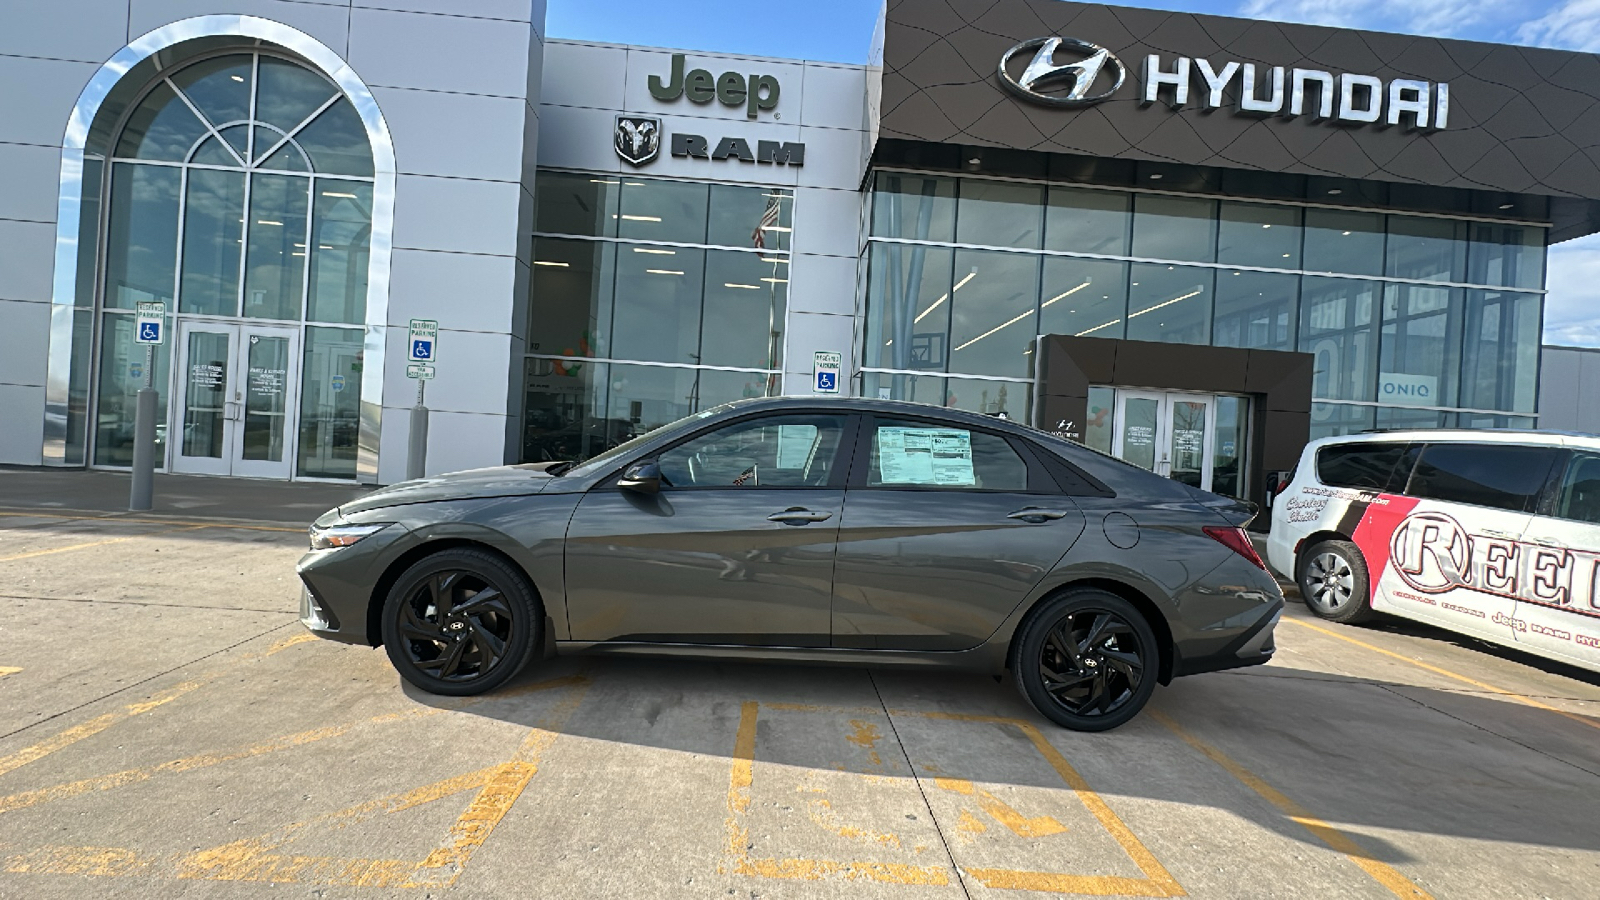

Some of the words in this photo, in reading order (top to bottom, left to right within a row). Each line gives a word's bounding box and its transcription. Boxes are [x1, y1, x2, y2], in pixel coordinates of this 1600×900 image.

[648, 53, 780, 119] Jeep
[1143, 53, 1449, 133] HYUNDAI
[671, 132, 806, 167] RAM
[138, 311, 164, 319] PARKING
[411, 329, 436, 337] PARKING
[412, 322, 436, 330] RESERVED
[816, 361, 839, 369] PARKING
[1492, 612, 1527, 633] Jeep
[1531, 623, 1571, 641] RAM
